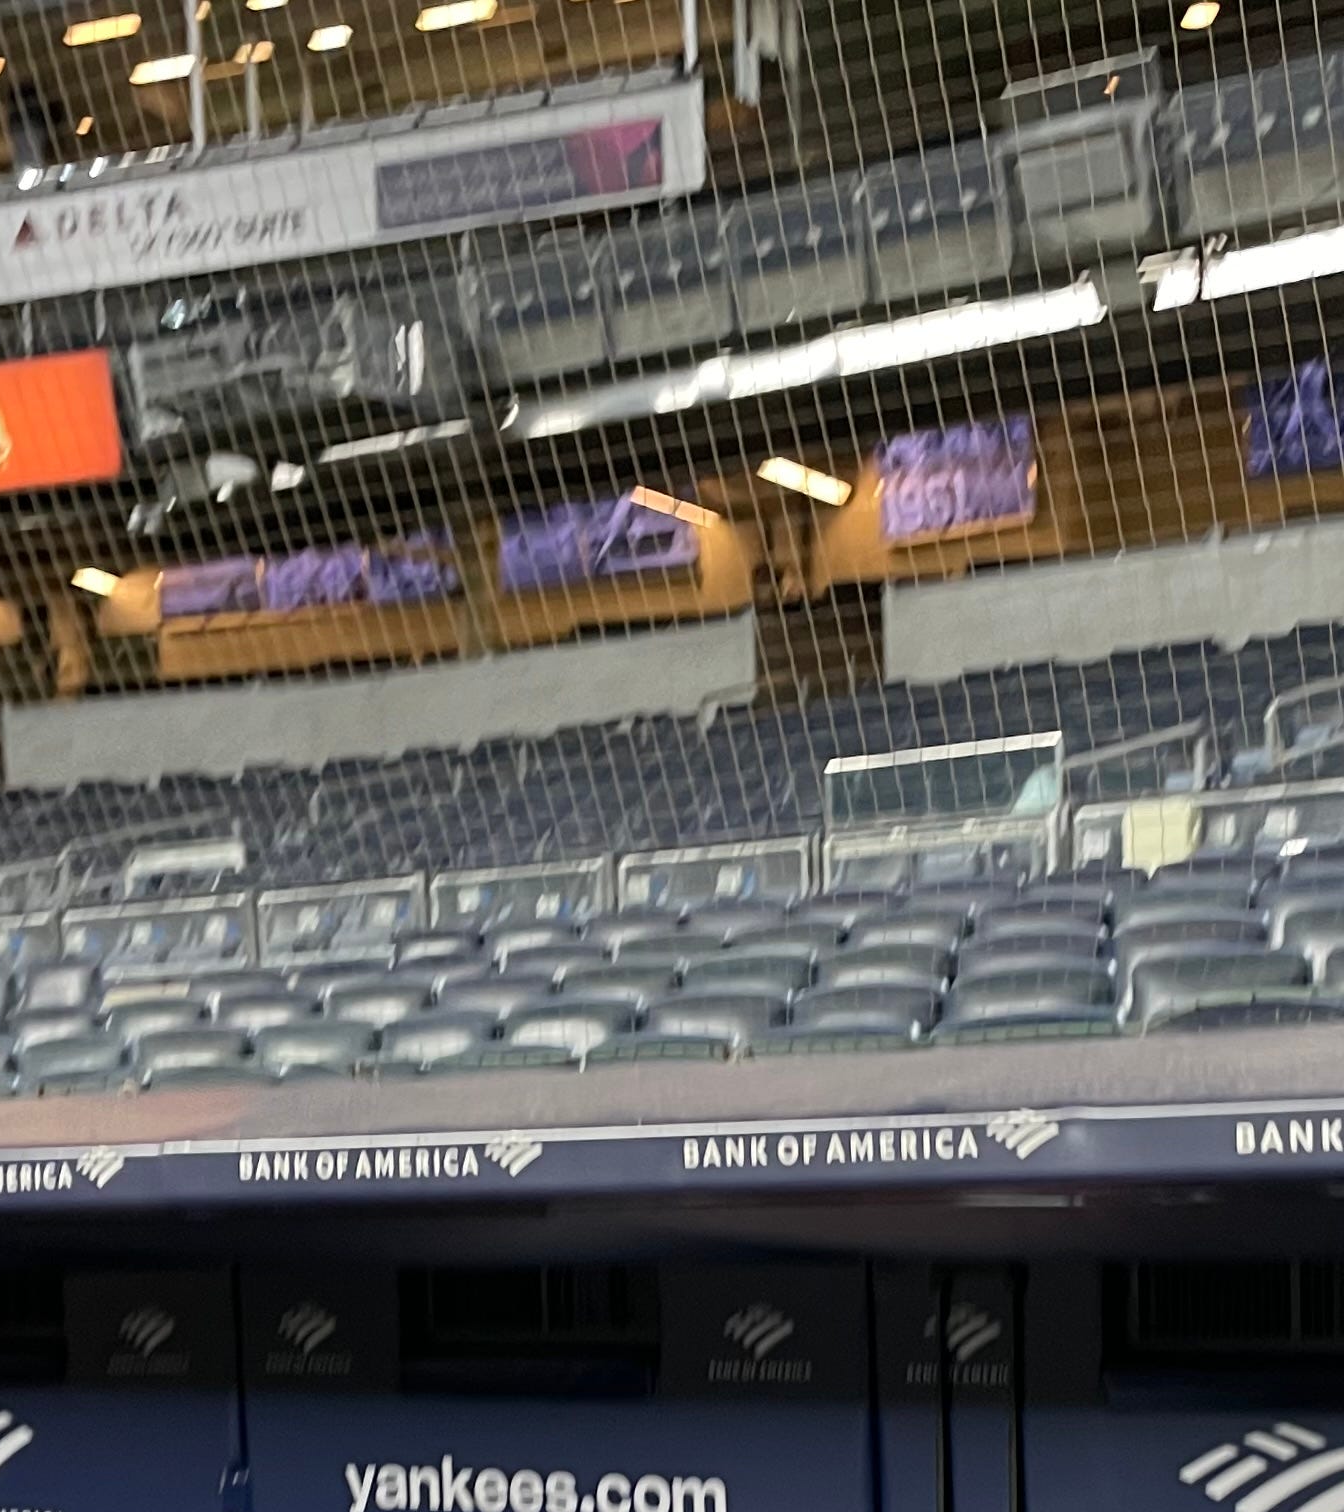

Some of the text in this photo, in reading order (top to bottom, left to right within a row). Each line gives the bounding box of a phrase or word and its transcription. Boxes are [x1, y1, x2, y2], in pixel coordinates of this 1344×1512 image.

[683, 1127, 978, 1169] BANK OF AMERICA
[1235, 1118, 1344, 1155] BANK
[238, 1147, 479, 1181] BANK OF AMERICA
